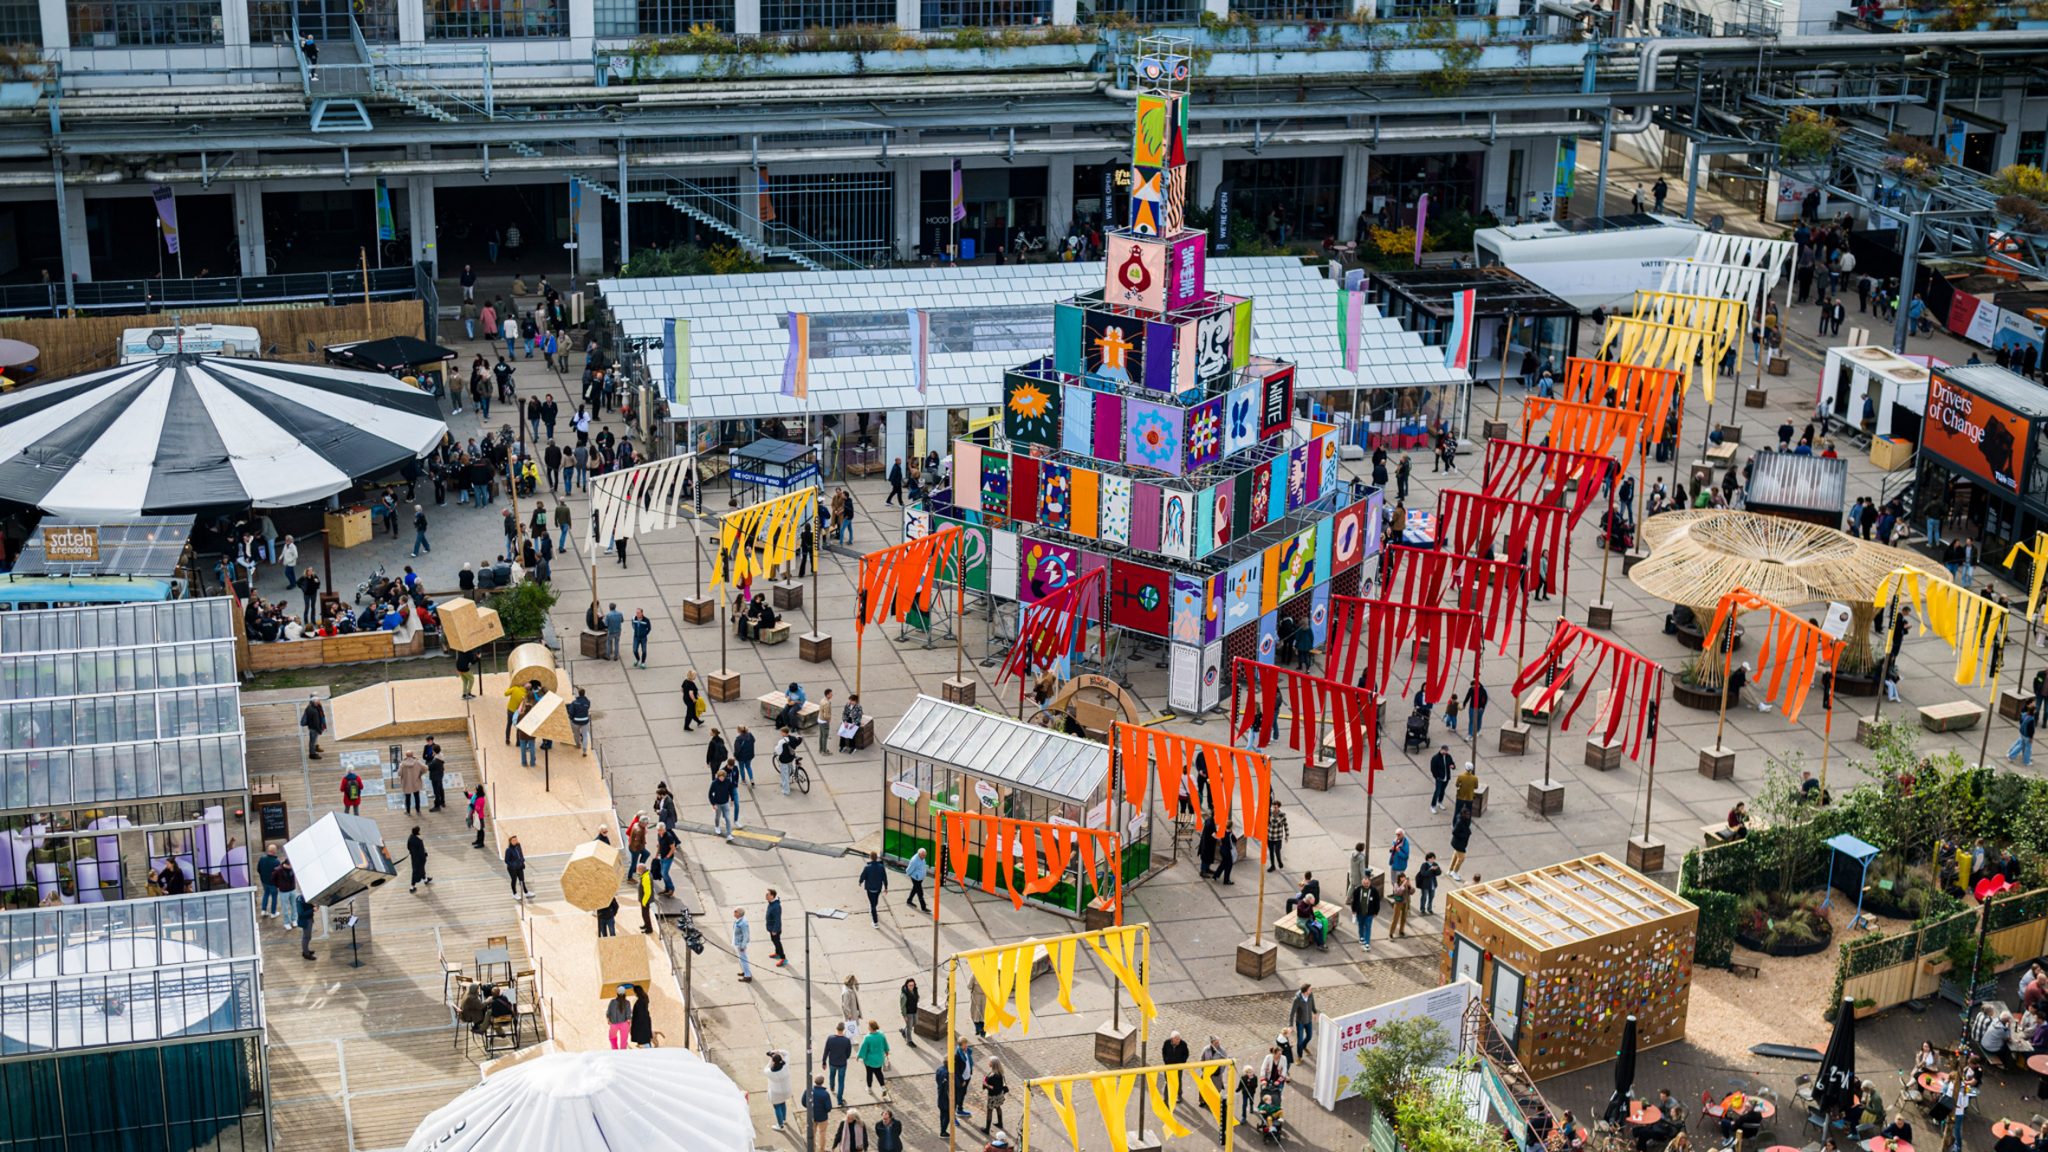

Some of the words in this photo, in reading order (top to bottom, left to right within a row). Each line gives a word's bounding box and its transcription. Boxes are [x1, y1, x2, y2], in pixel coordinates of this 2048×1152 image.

[1220, 191, 1228, 213] OPEN
[926, 216, 950, 224] MOOD
[1267, 380, 1285, 425] WHITE
[1932, 379, 1973, 416] Drivers
[1929, 402, 1944, 421] of
[1942, 407, 1987, 444] Change
[755, 475, 768, 484] WANT
[50, 528, 93, 547] sateh
